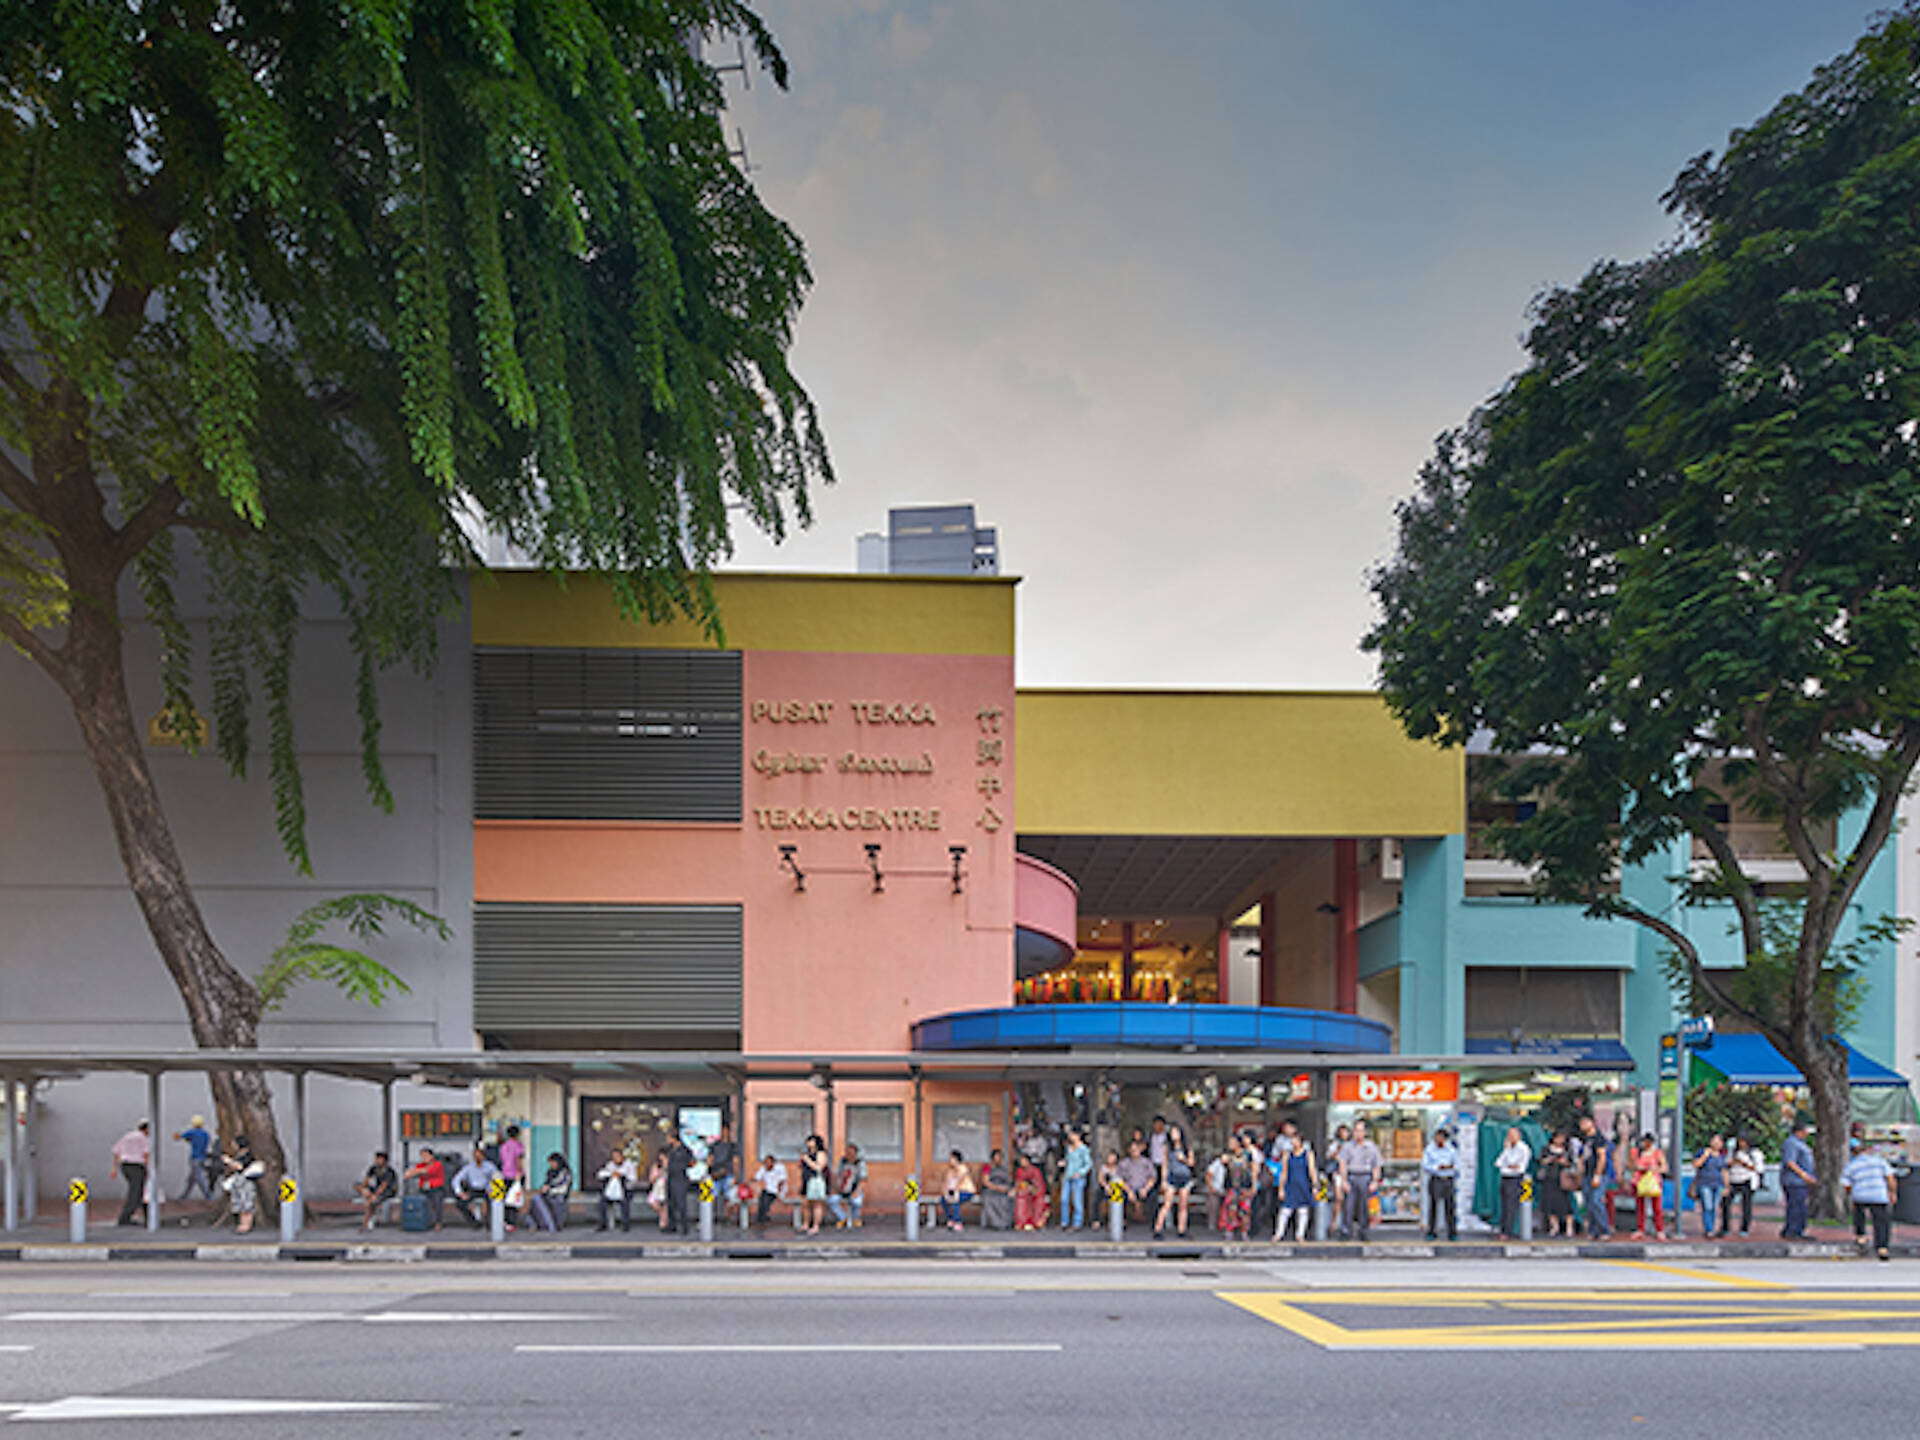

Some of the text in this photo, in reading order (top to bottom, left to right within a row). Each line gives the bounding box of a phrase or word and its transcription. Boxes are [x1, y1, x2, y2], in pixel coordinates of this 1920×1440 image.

[752, 700, 936, 726] PUSAT TEKKA
[754, 806, 941, 831] TEKKA CENTRE
[1359, 1073, 1433, 1100] buzz
